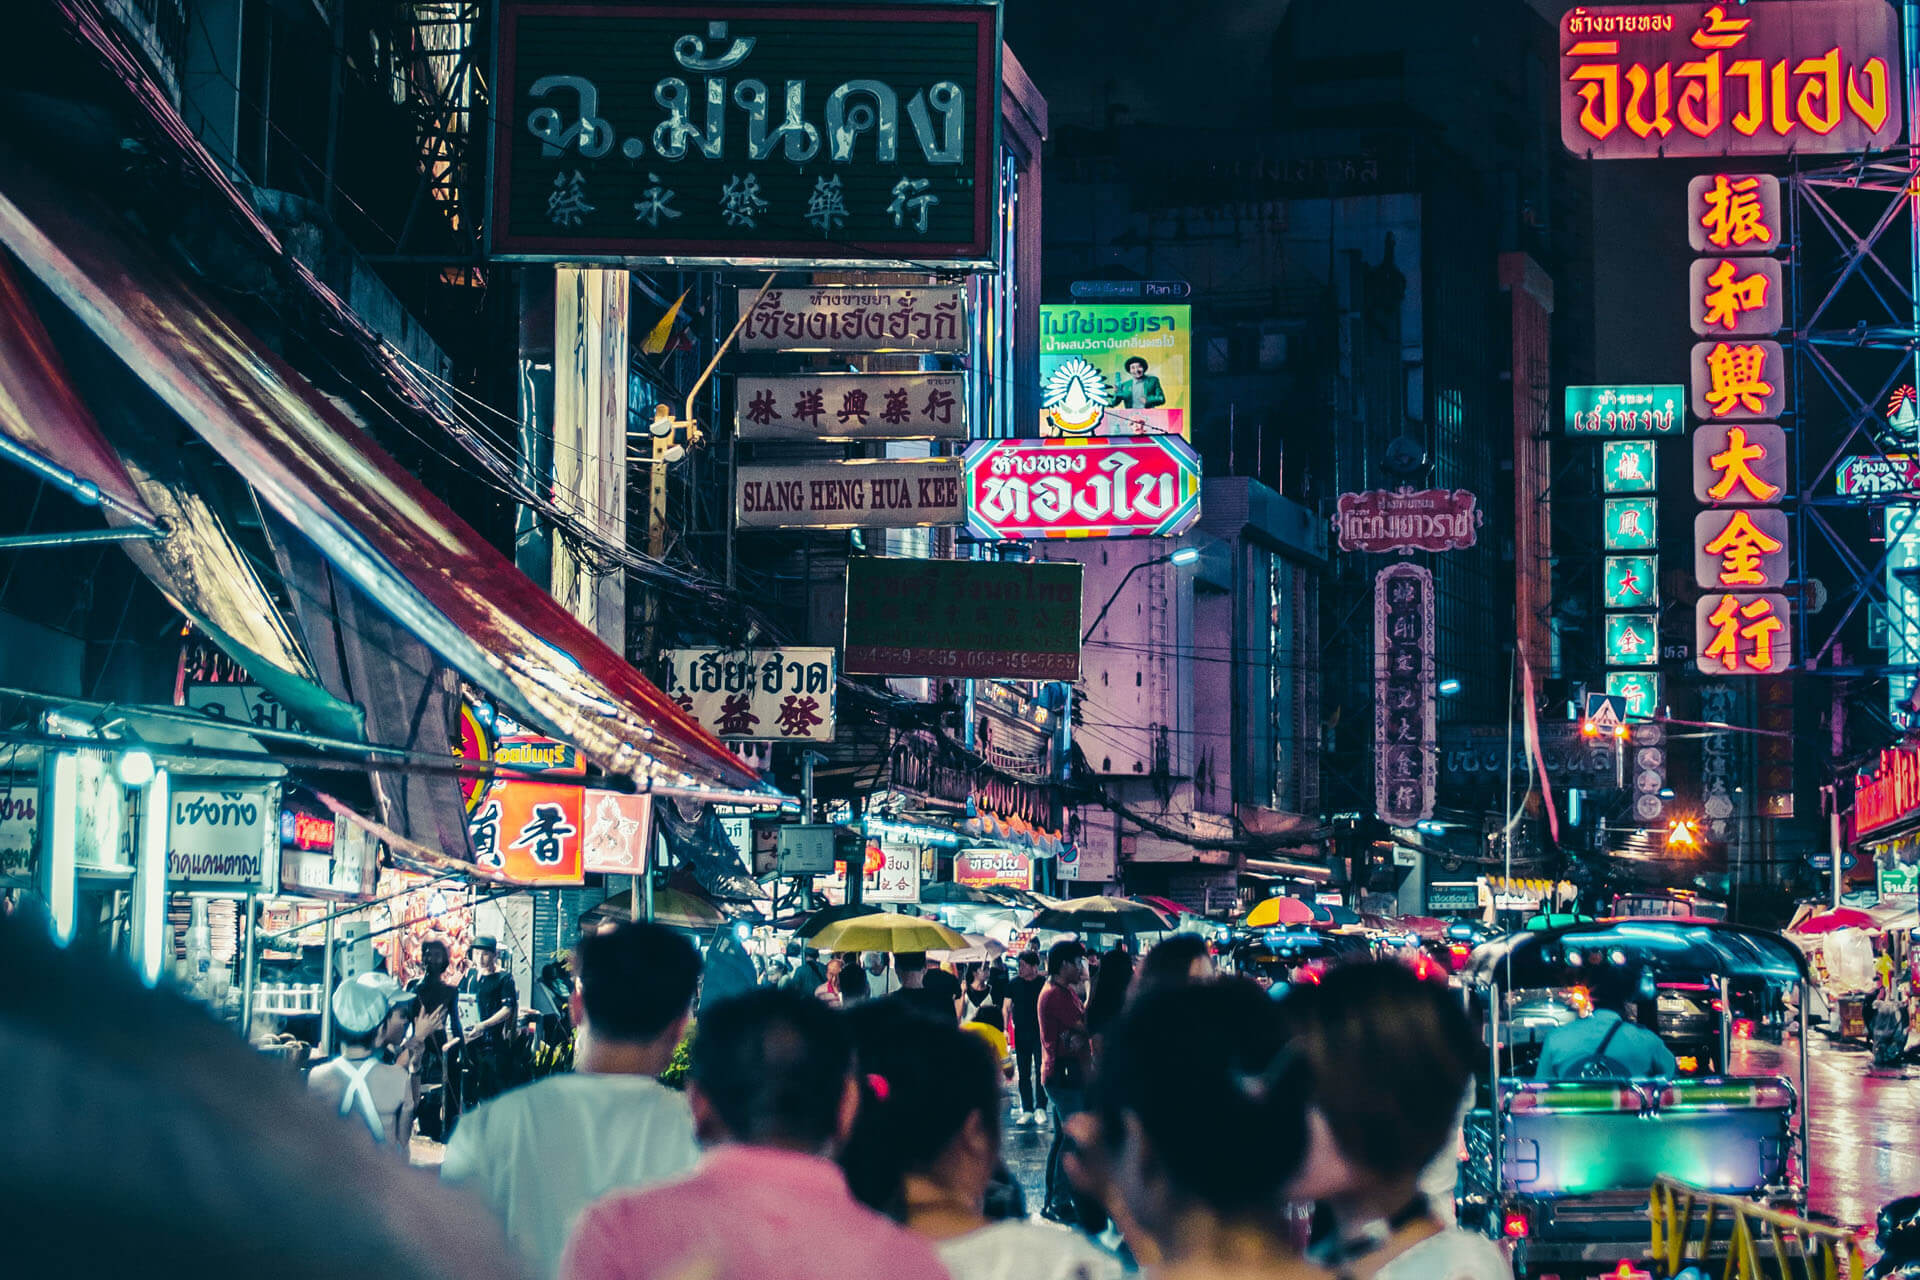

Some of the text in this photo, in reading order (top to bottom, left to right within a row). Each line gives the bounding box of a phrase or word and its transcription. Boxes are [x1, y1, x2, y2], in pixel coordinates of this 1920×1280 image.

[1569, 8, 1675, 33] ห้างขายทอง
[528, 21, 965, 164] ฉ.มั่นคง
[810, 291, 891, 306] ห้างขายยา
[1146, 284, 1170, 295] Plan
[1701, 175, 1783, 671] 振和興大金行
[990, 448, 1087, 475] ห้างทอง
[743, 477, 958, 512] SIANG HENG HUA KEE
